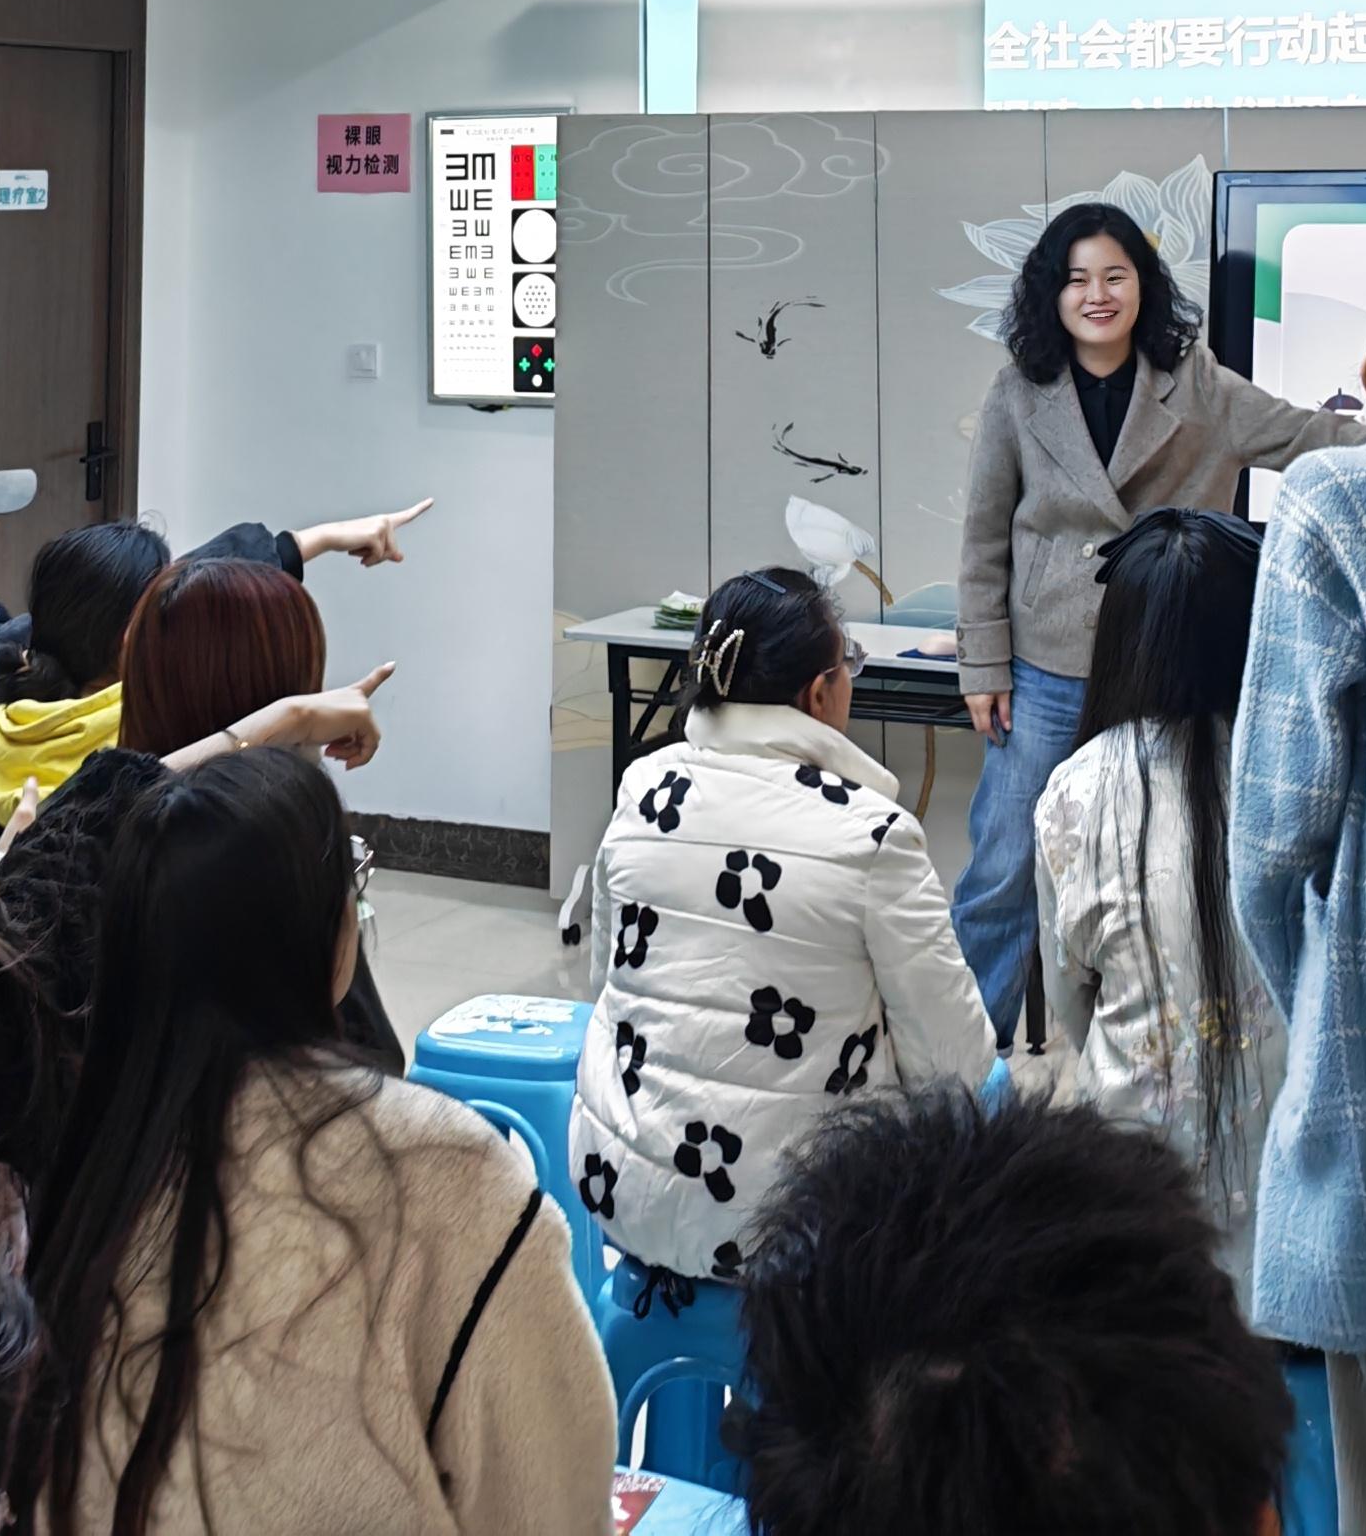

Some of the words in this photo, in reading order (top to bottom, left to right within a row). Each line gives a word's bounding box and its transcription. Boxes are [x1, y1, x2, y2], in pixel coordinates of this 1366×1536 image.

[344, 125, 382, 146] 裸眼
[326, 154, 400, 175] 视力检测
